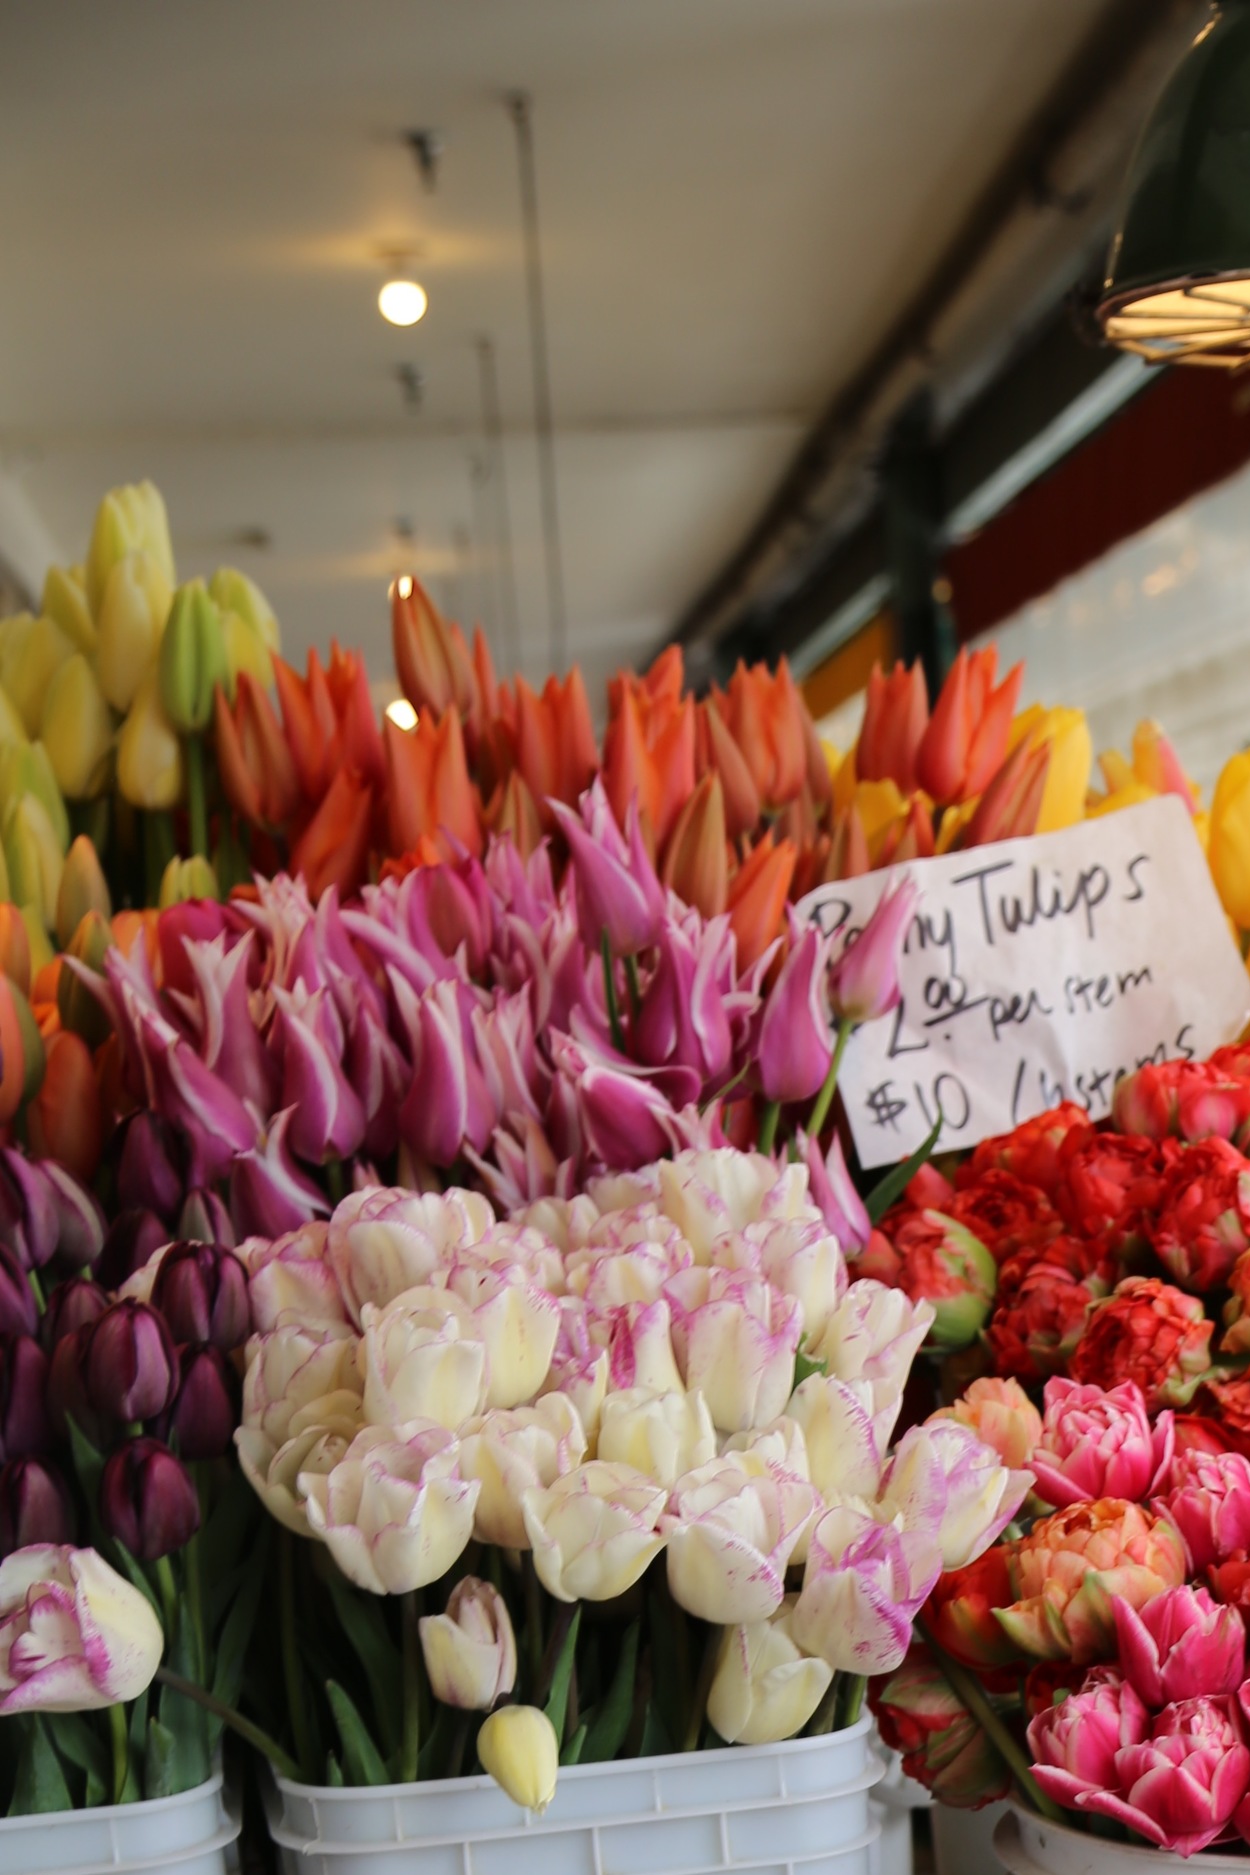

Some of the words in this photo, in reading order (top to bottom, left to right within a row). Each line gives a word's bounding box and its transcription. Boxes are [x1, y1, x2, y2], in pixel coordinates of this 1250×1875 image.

[809, 898, 957, 976] Pny
[952, 853, 1150, 944] Tulips
[989, 993, 1052, 1041] per
[1063, 965, 1154, 1013] stem
[866, 1072, 971, 1143] $10
